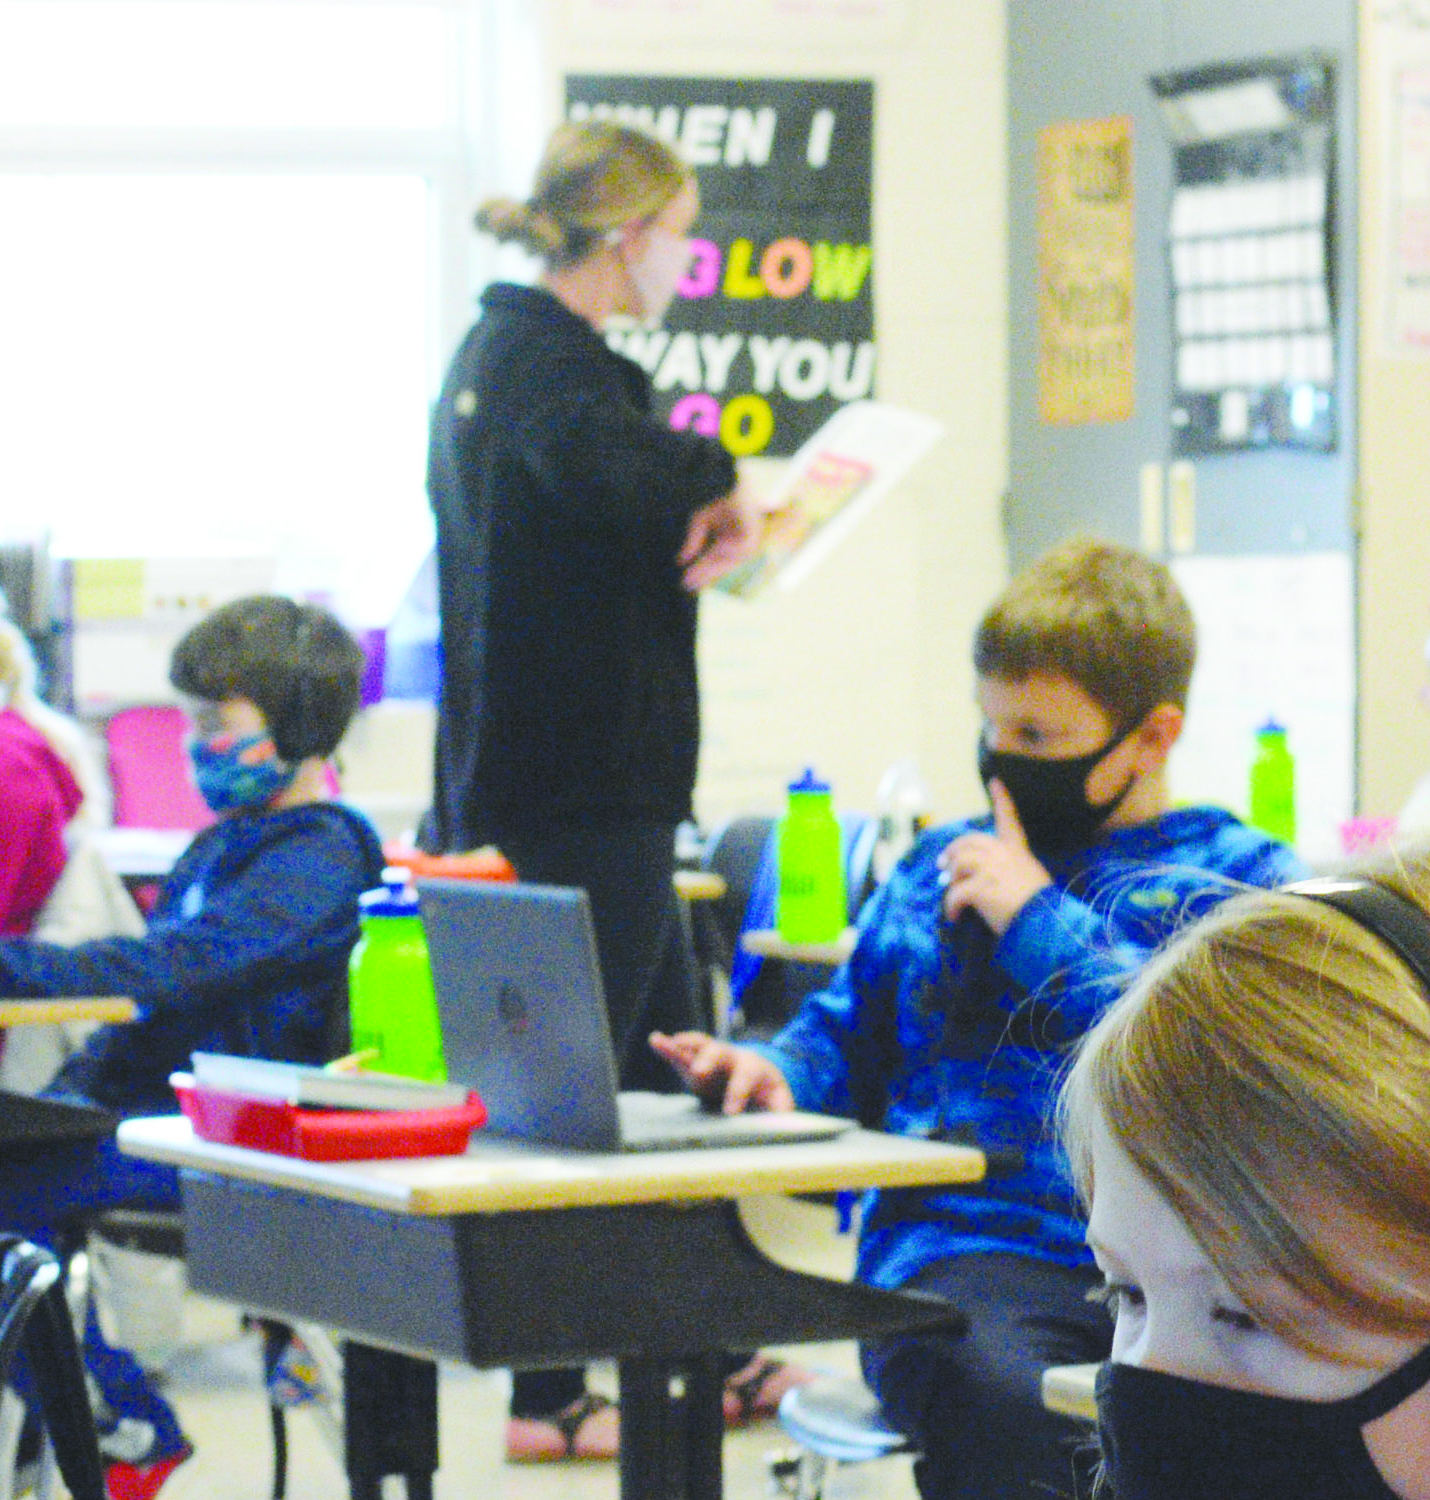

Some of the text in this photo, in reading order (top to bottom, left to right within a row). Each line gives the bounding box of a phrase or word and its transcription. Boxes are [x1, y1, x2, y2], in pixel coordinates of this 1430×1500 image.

[806, 107, 836, 168] I
[676, 237, 871, 301] GLOW
[604, 331, 876, 401] WAY YOU
